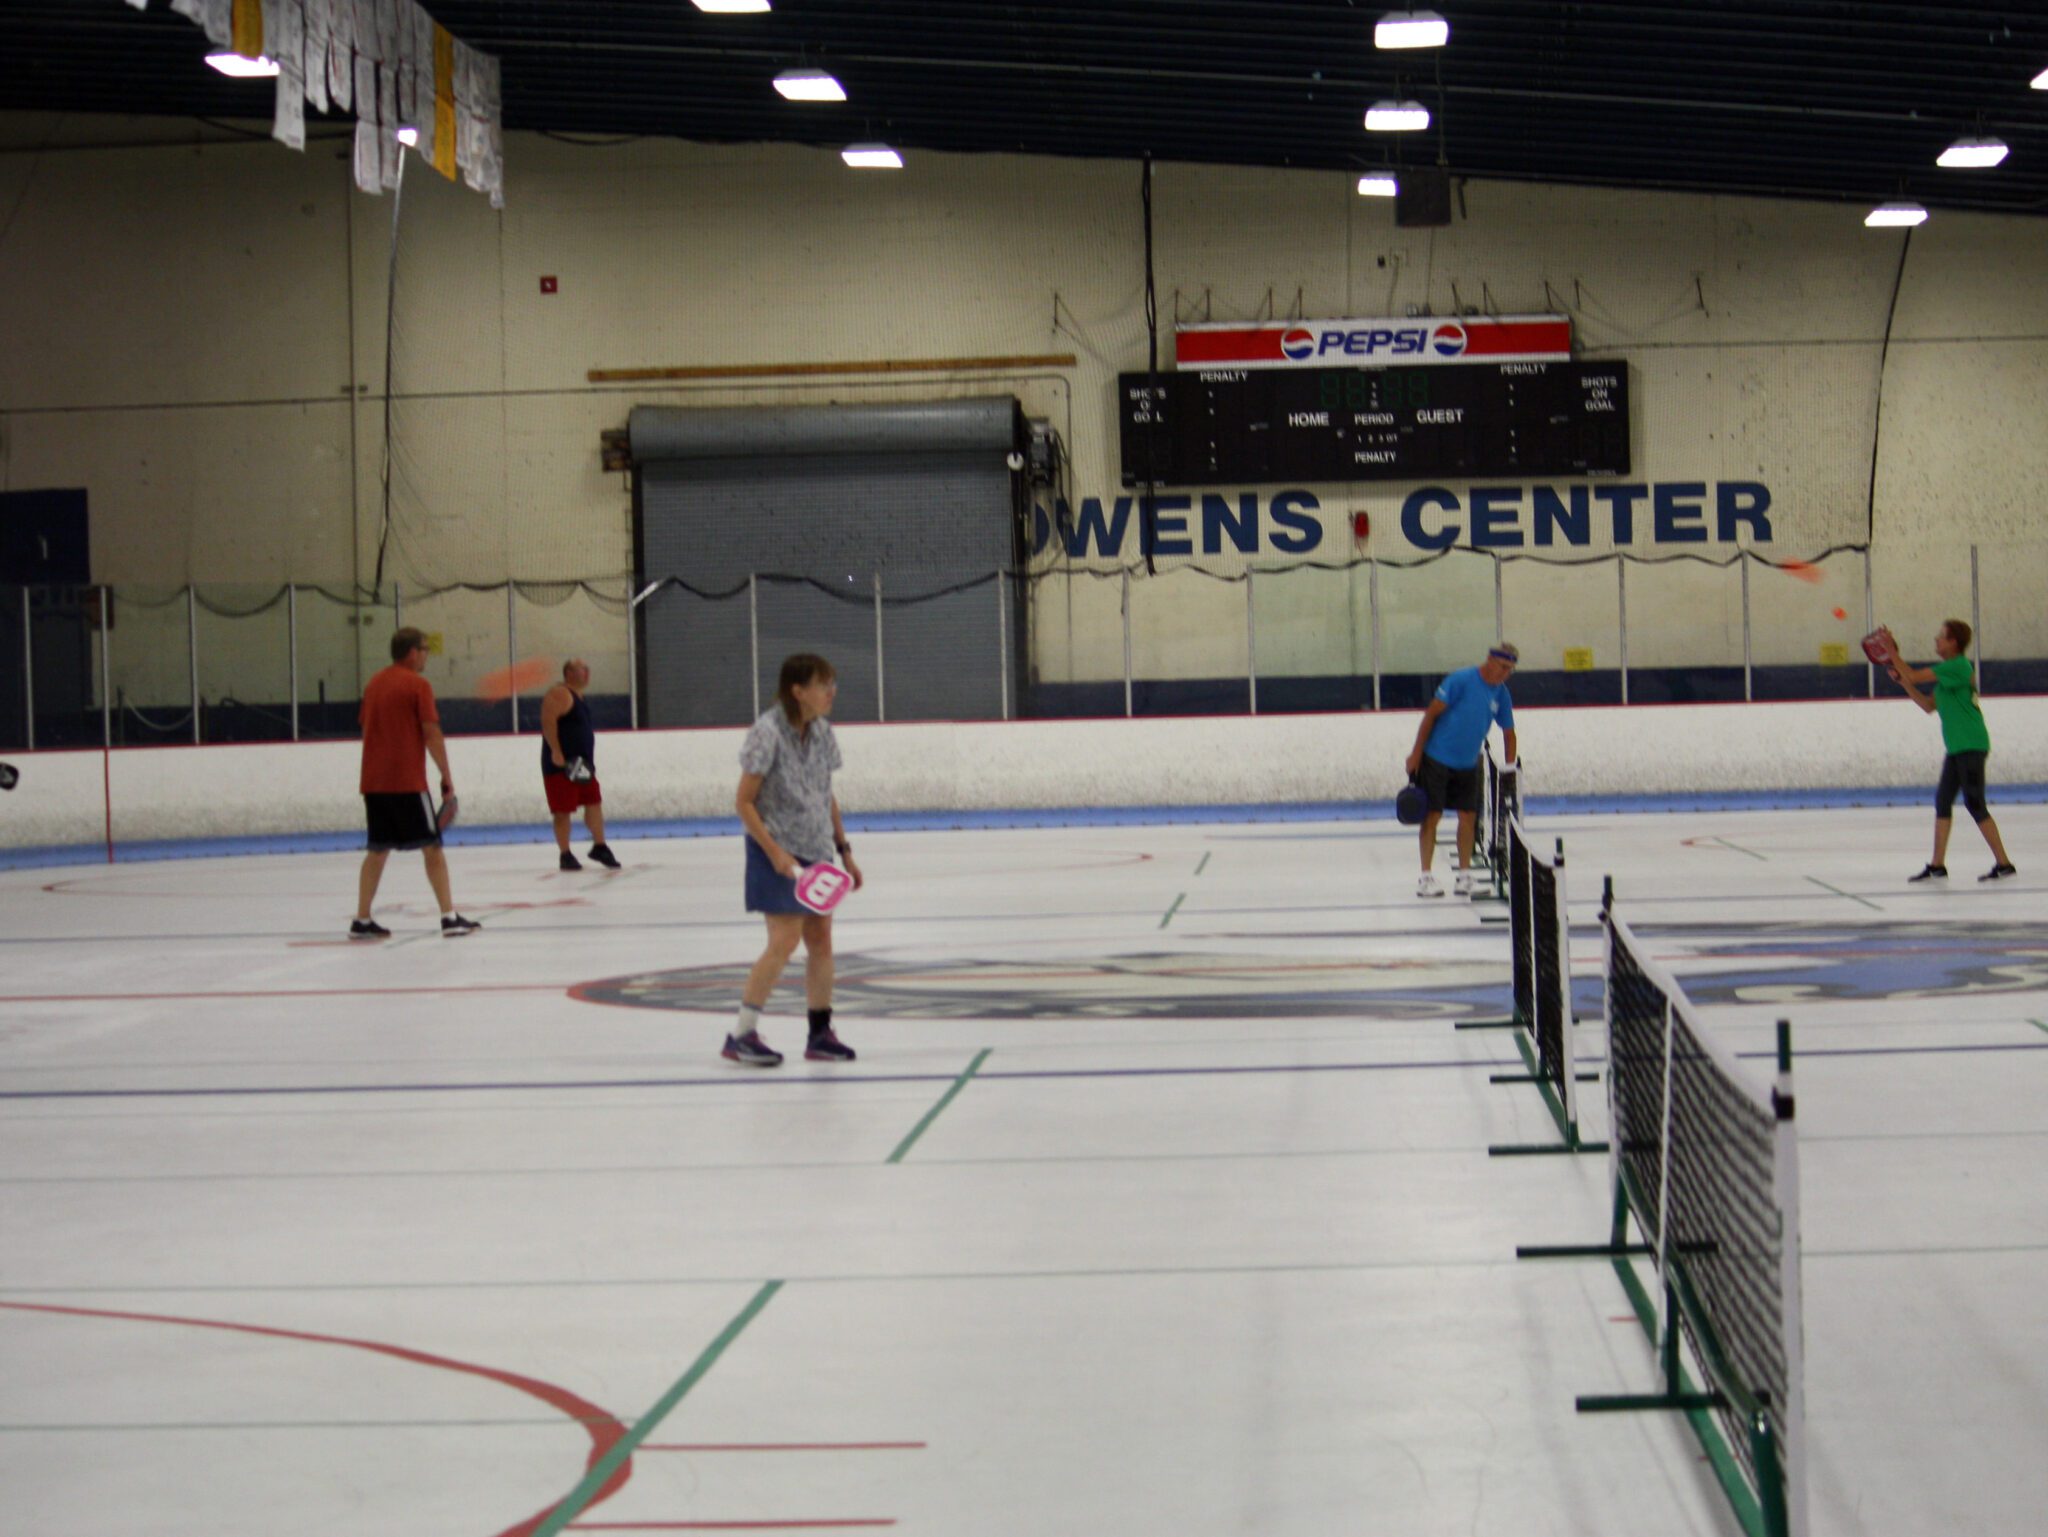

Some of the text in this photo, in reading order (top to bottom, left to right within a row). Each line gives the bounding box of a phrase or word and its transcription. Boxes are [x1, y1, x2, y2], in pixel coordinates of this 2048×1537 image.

[1318, 328, 1428, 356] PEPSI
[1500, 362, 1547, 375] PENALTY
[1200, 369, 1249, 383] PENALTY
[1581, 375, 1618, 388] SHOTS
[1591, 388, 1609, 400] ON
[1584, 400, 1616, 412] GOAL
[1133, 410, 1164, 423] GOL
[1288, 411, 1330, 427] HOME
[1353, 412, 1394, 426] PERIOD
[1416, 408, 1464, 424] GUEST
[1354, 450, 1397, 463] PENALTY
[1400, 480, 1774, 551] CENTER
